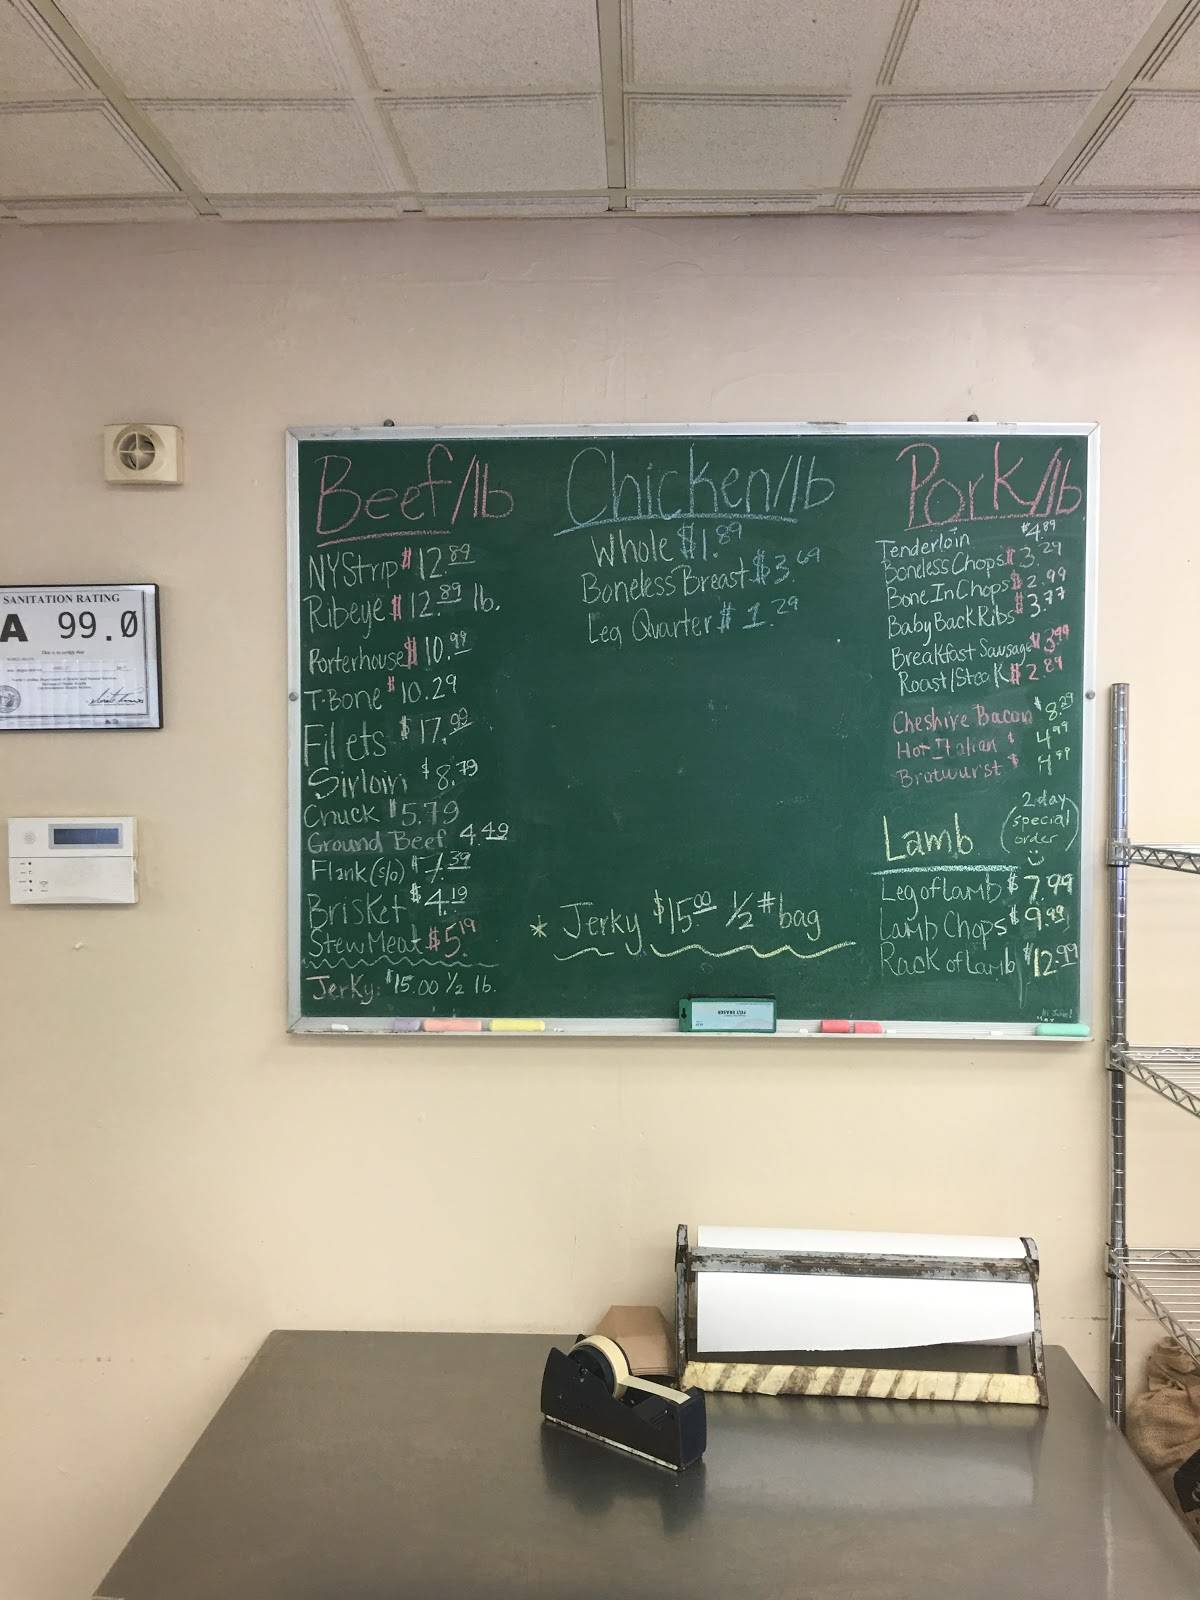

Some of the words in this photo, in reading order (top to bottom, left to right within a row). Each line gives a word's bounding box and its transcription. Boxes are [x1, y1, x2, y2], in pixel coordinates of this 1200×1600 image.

[590, 528, 674, 568] Whole
[875, 527, 971, 562] Tenderloin
[3, 595, 74, 605] SANITATION
[76, 593, 121, 603] RATING
[303, 594, 386, 639] Ribeye
[0, 613, 29, 642] A
[307, 645, 410, 676] Porterhouse
[883, 812, 974, 862] Lamb
[560, 900, 643, 956] Jerky
